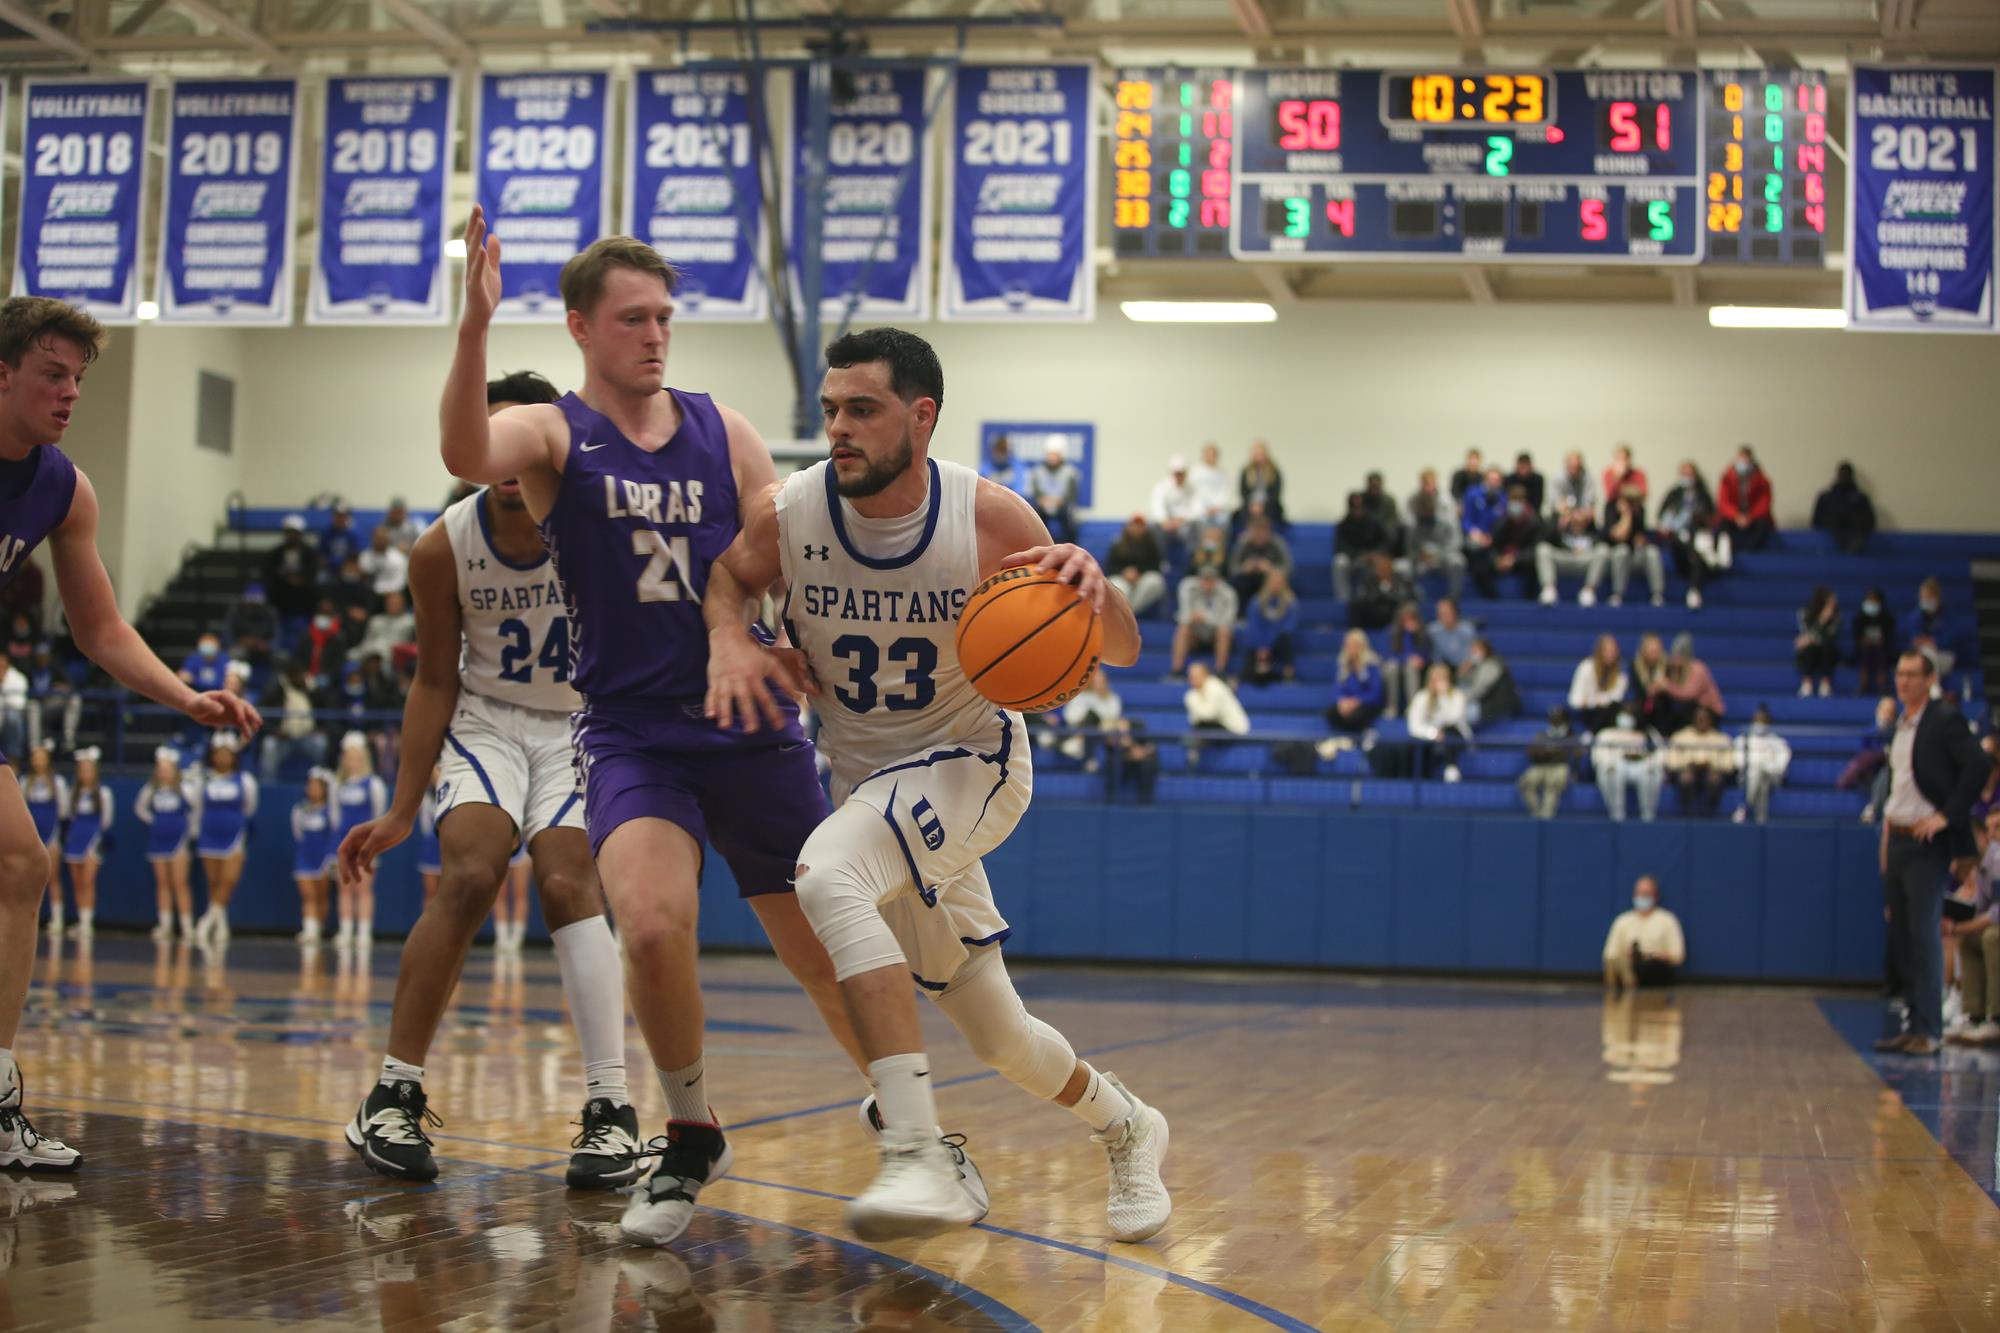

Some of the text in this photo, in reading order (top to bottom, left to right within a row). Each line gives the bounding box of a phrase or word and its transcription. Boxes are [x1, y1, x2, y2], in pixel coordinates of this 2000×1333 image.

[1180, 82, 1192, 107] 1
[1411, 75, 1543, 123] 10:23
[1585, 73, 1685, 98] VISITOR
[1724, 83, 1825, 112] 0 0 11
[1890, 73, 1958, 95] MEN'S
[31, 95, 144, 118] VOLLEYBALL
[1179, 111, 1192, 138] 1
[1203, 111, 1232, 138] 11
[1279, 100, 1341, 151] 50
[1610, 101, 1671, 152] 51
[1857, 94, 1991, 119] BASKETBALL
[646, 123, 749, 167] 2021
[802, 120, 914, 167] 020
[963, 119, 1072, 166] 2021
[1733, 115, 1743, 141] 1
[1765, 113, 1783, 142] 0
[35, 134, 132, 175] 2018
[180, 133, 281, 175] 2019
[333, 129, 437, 172] 2019
[487, 125, 595, 171] 2020
[1179, 141, 1191, 167] 1
[1486, 136, 1513, 176] 2
[1773, 144, 1783, 171] 1
[1871, 124, 1977, 172] 2021
[1708, 173, 1743, 201] 21
[1764, 173, 1783, 202] 2
[1169, 199, 1189, 228] 2
[1285, 198, 1311, 238] 3
[1326, 199, 1355, 237] 4
[1580, 199, 1607, 240] 5
[1648, 200, 1674, 241] 5
[1708, 203, 1824, 233] 22 3 4
[1877, 221, 1968, 246] CONFERENCE
[1878, 246, 1967, 271] CHAMPIONS
[604, 475, 703, 523] LORAS
[632, 529, 697, 603] 21
[470, 580, 565, 611] SPARTA
[804, 585, 966, 623] SPARTANS
[498, 616, 568, 683] 24
[831, 634, 938, 714] 33
